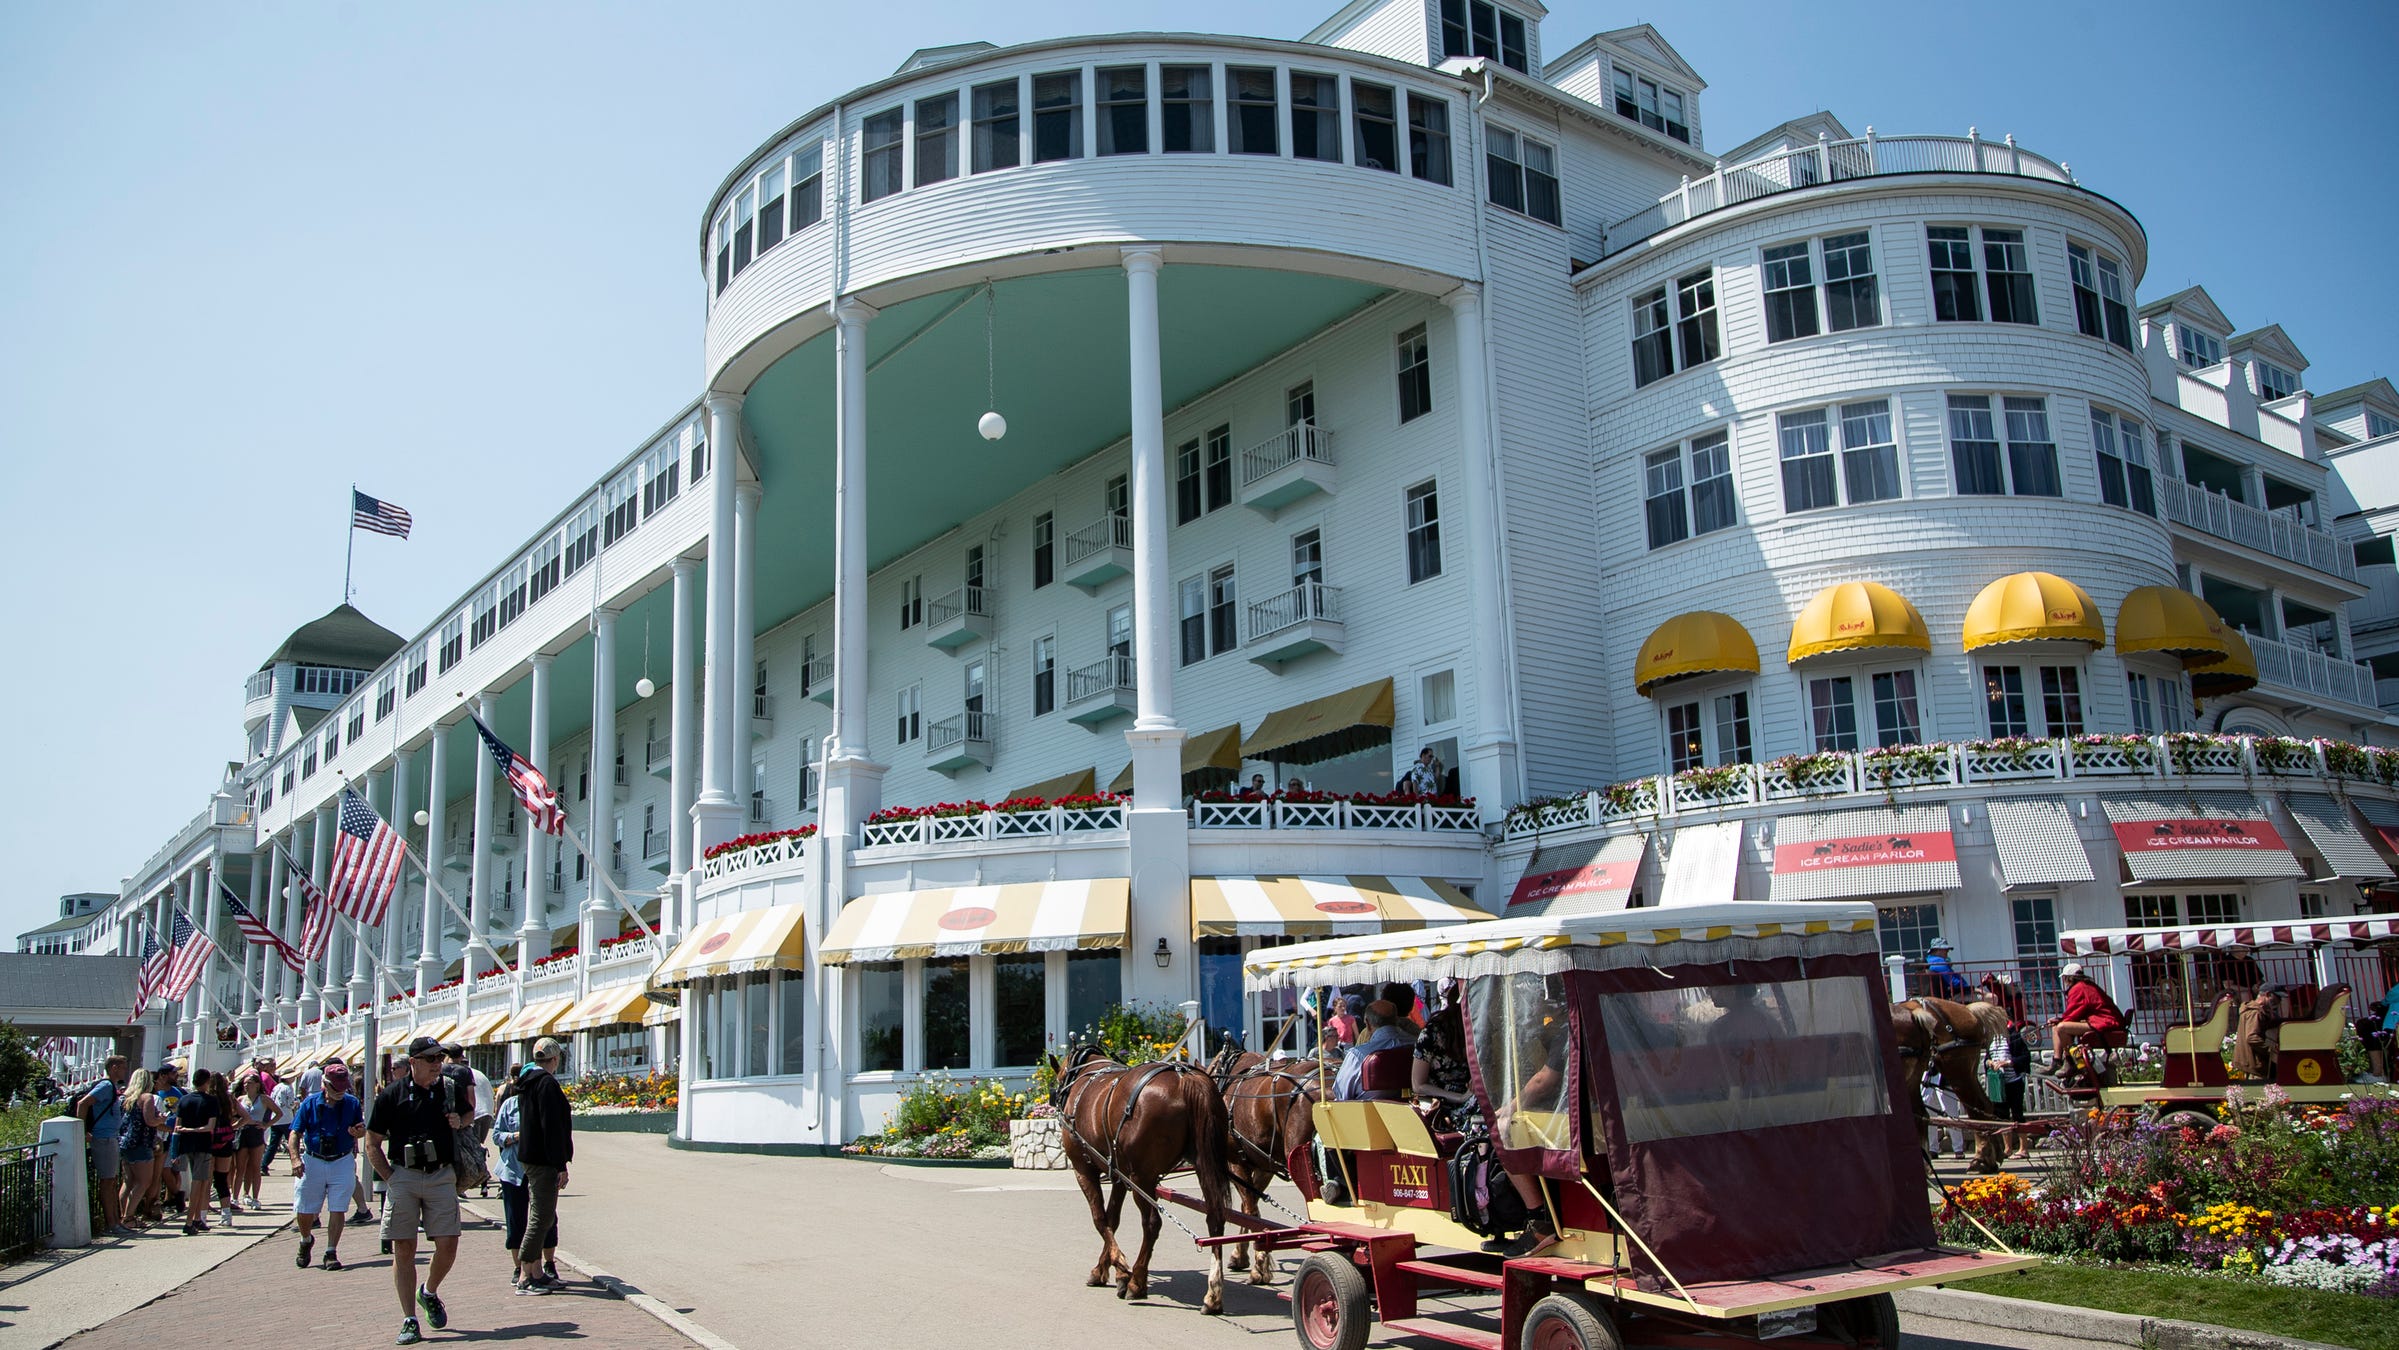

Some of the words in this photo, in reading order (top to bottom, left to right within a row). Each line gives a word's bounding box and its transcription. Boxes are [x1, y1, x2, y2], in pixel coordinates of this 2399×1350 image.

[1841, 840, 1883, 853] Sadie's
[2146, 837, 2167, 846] ICE
[2168, 836, 2212, 845] CREAM
[2213, 836, 2260, 845] PARLOR
[1800, 857, 1821, 867] ICE
[1823, 854, 1870, 864] CREAM
[1873, 849, 1925, 860] PARLOR
[1527, 888, 1541, 898] ICE
[1542, 883, 1575, 895] CREAM
[1575, 878, 1613, 889] PARLOR
[1389, 1164, 1429, 1186] TAXI
